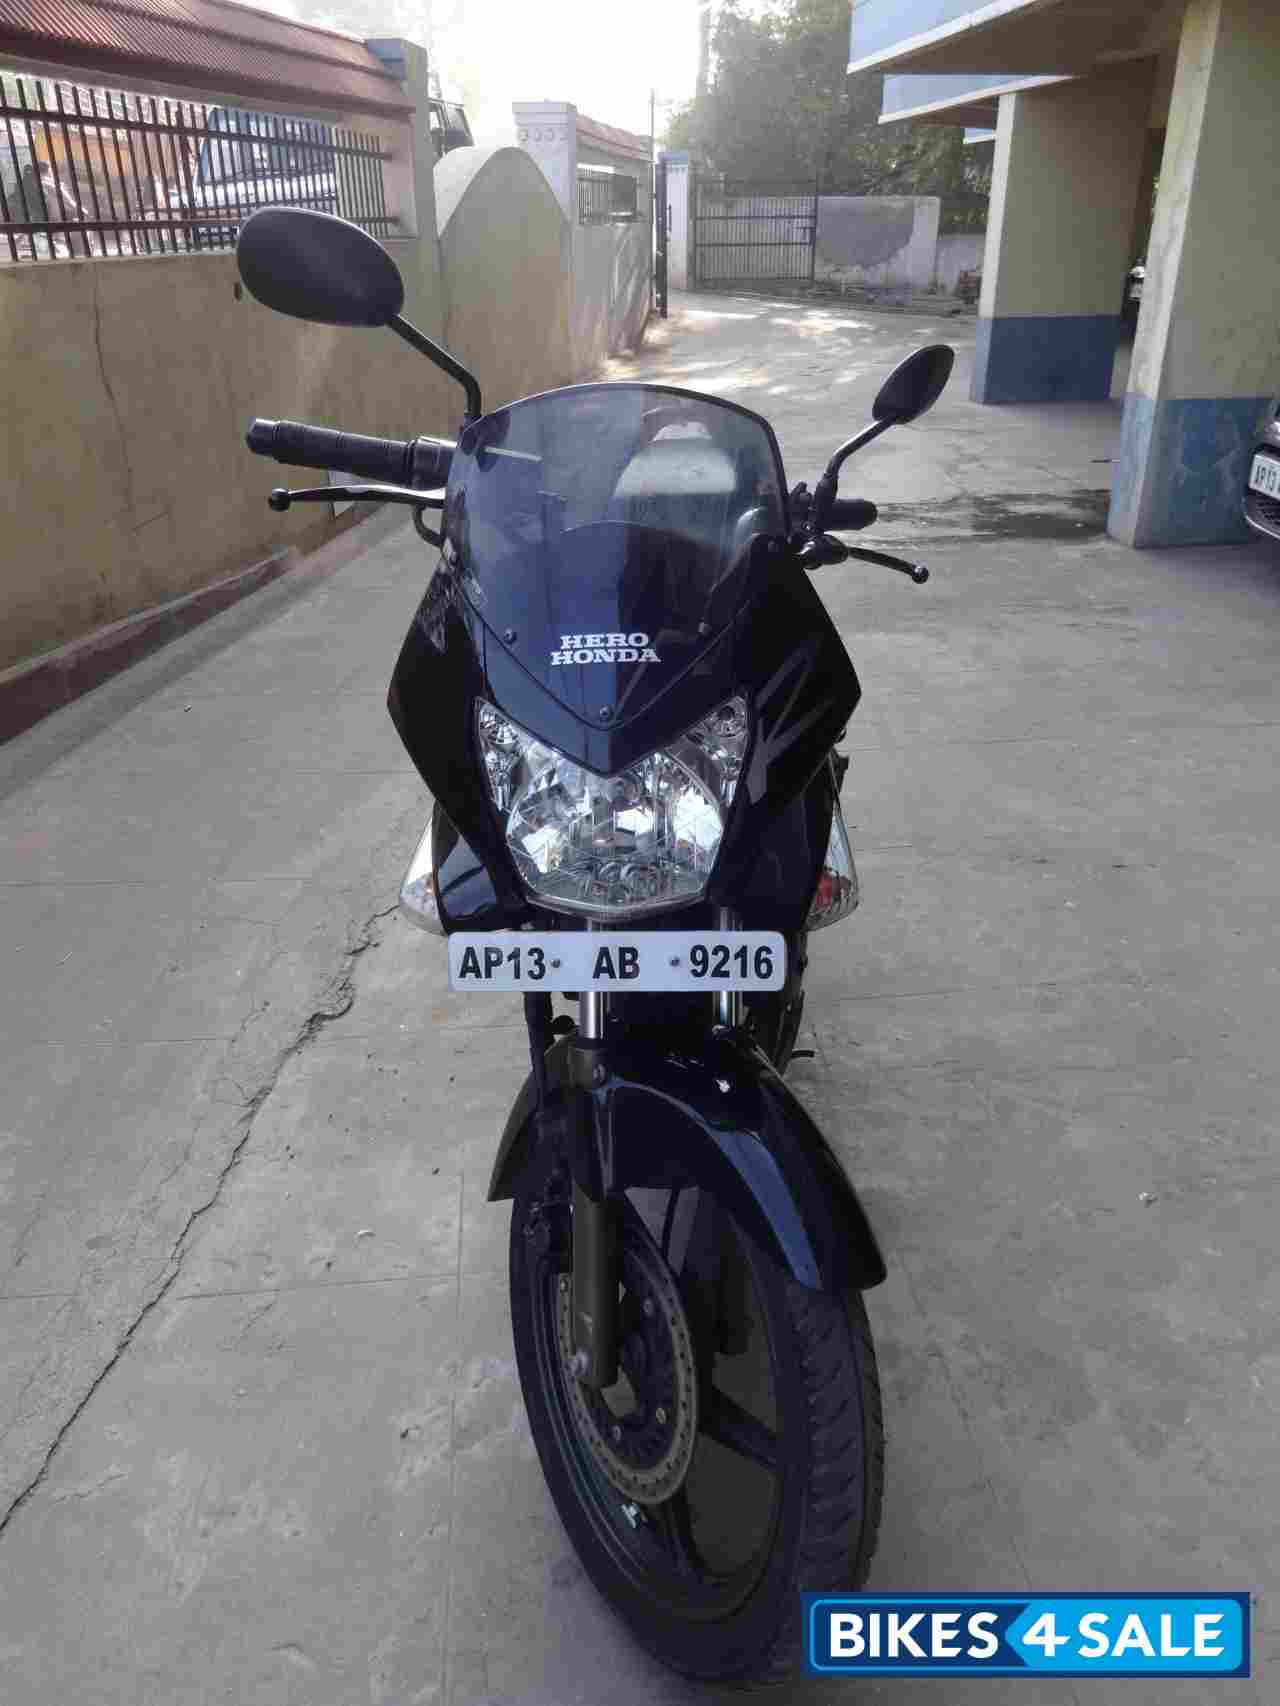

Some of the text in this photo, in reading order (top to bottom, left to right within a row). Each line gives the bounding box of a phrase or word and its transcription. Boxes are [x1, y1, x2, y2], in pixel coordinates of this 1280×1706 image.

[560, 633, 649, 649] HERO
[551, 648, 662, 665] HONDA
[458, 945, 774, 980] AP13 AB 9216
